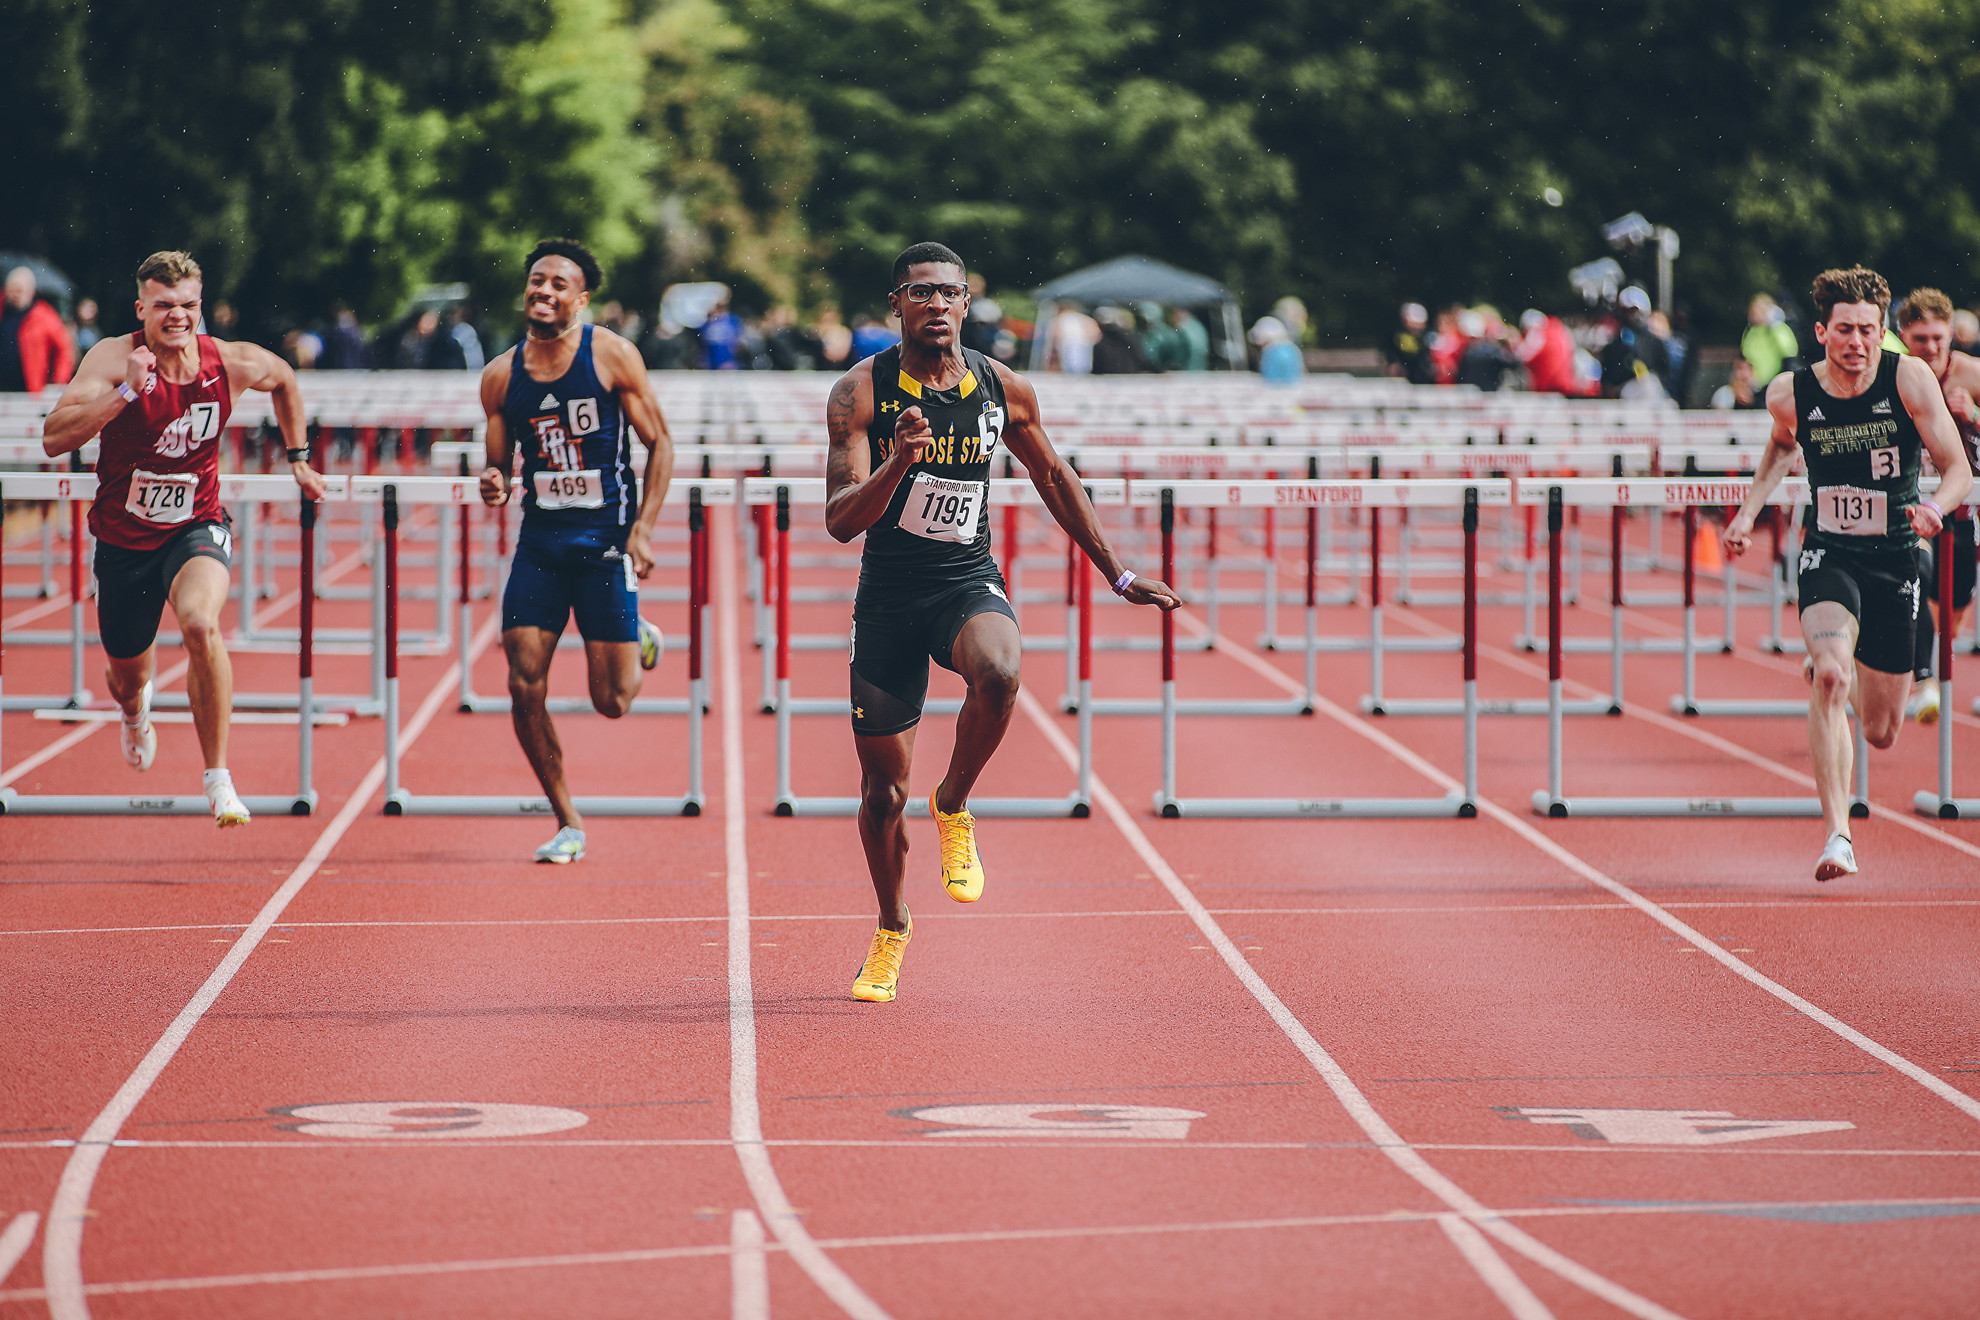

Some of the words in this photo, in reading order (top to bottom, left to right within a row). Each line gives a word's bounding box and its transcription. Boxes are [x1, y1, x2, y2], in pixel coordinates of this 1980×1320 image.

[198, 407, 212, 437] 7
[576, 403, 591, 430] 6
[984, 411, 999, 452] 5
[1810, 419, 1898, 442] SACRAMENTO
[1878, 451, 1894, 477] 3
[136, 485, 186, 508] 1728
[550, 476, 587, 496] 469
[925, 477, 961, 492] STANFORD
[961, 483, 979, 493] INVITE
[1275, 486, 1363, 503] STANFORD
[921, 492, 973, 526] 1195
[1832, 496, 1872, 519] 1131
